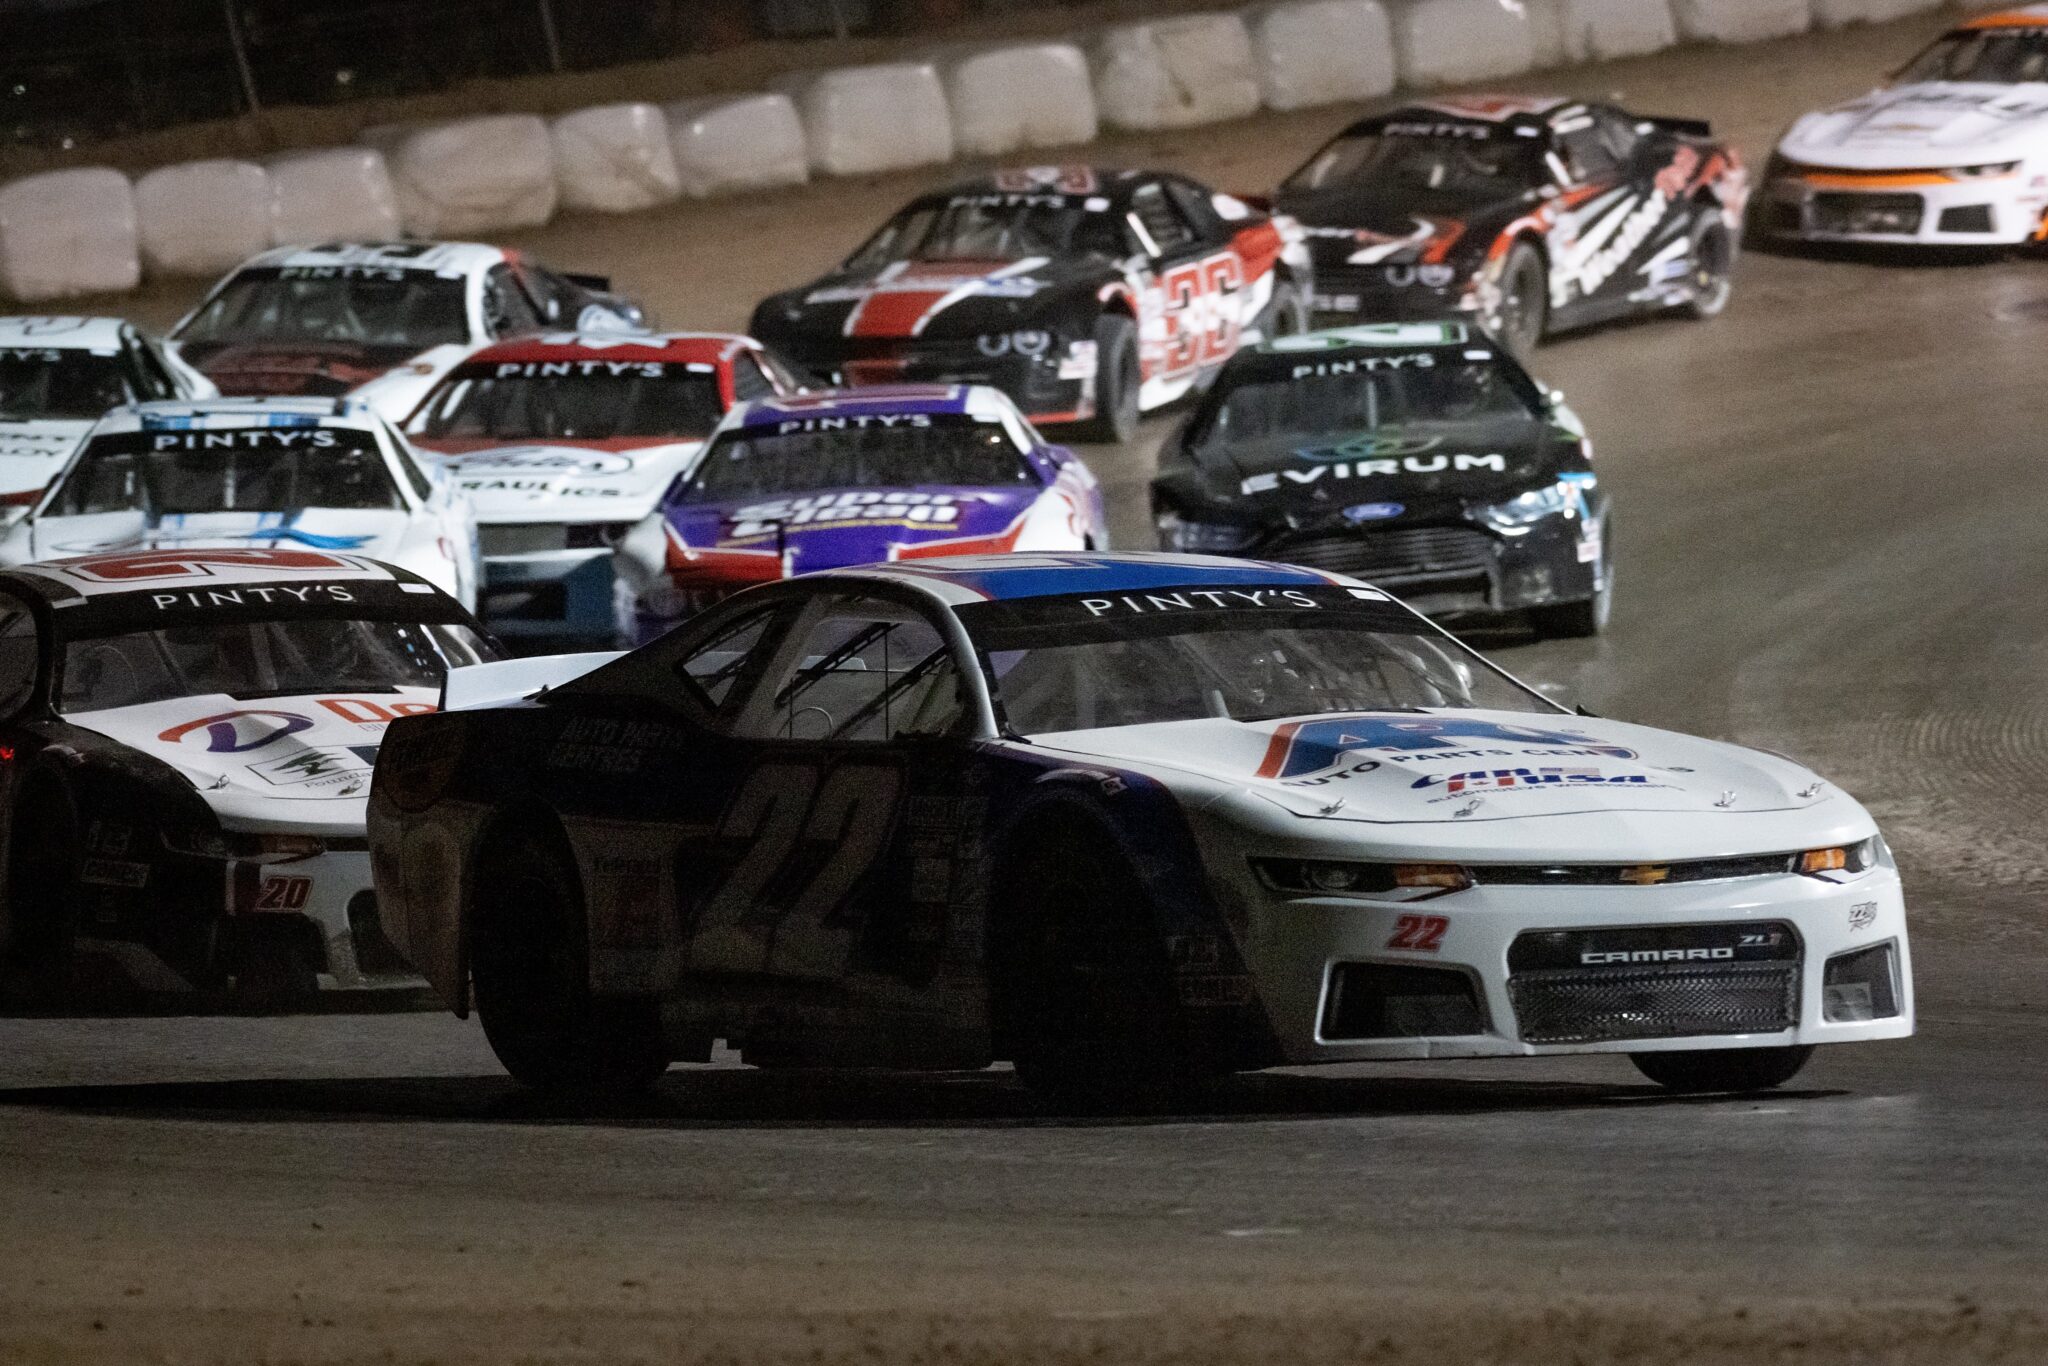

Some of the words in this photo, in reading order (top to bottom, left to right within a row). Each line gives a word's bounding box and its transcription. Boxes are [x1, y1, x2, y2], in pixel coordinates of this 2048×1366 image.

[496, 361, 664, 378] PINTY'S
[1292, 352, 1436, 379] PINTY'S
[778, 413, 932, 435] PINTY'S
[154, 431, 336, 451] PINTY'S
[1241, 453, 1506, 495] EVIRUM
[151, 583, 355, 610] PINTY'S
[1080, 588, 1319, 617] PINTY'S
[304, 770, 373, 789] Founda
[1280, 760, 1381, 787] AUTO
[1389, 749, 1513, 763] PARTS
[688, 758, 906, 979] 22
[255, 875, 314, 912] 20
[1384, 912, 1451, 953] 22
[1580, 946, 1734, 965] CAMARO
